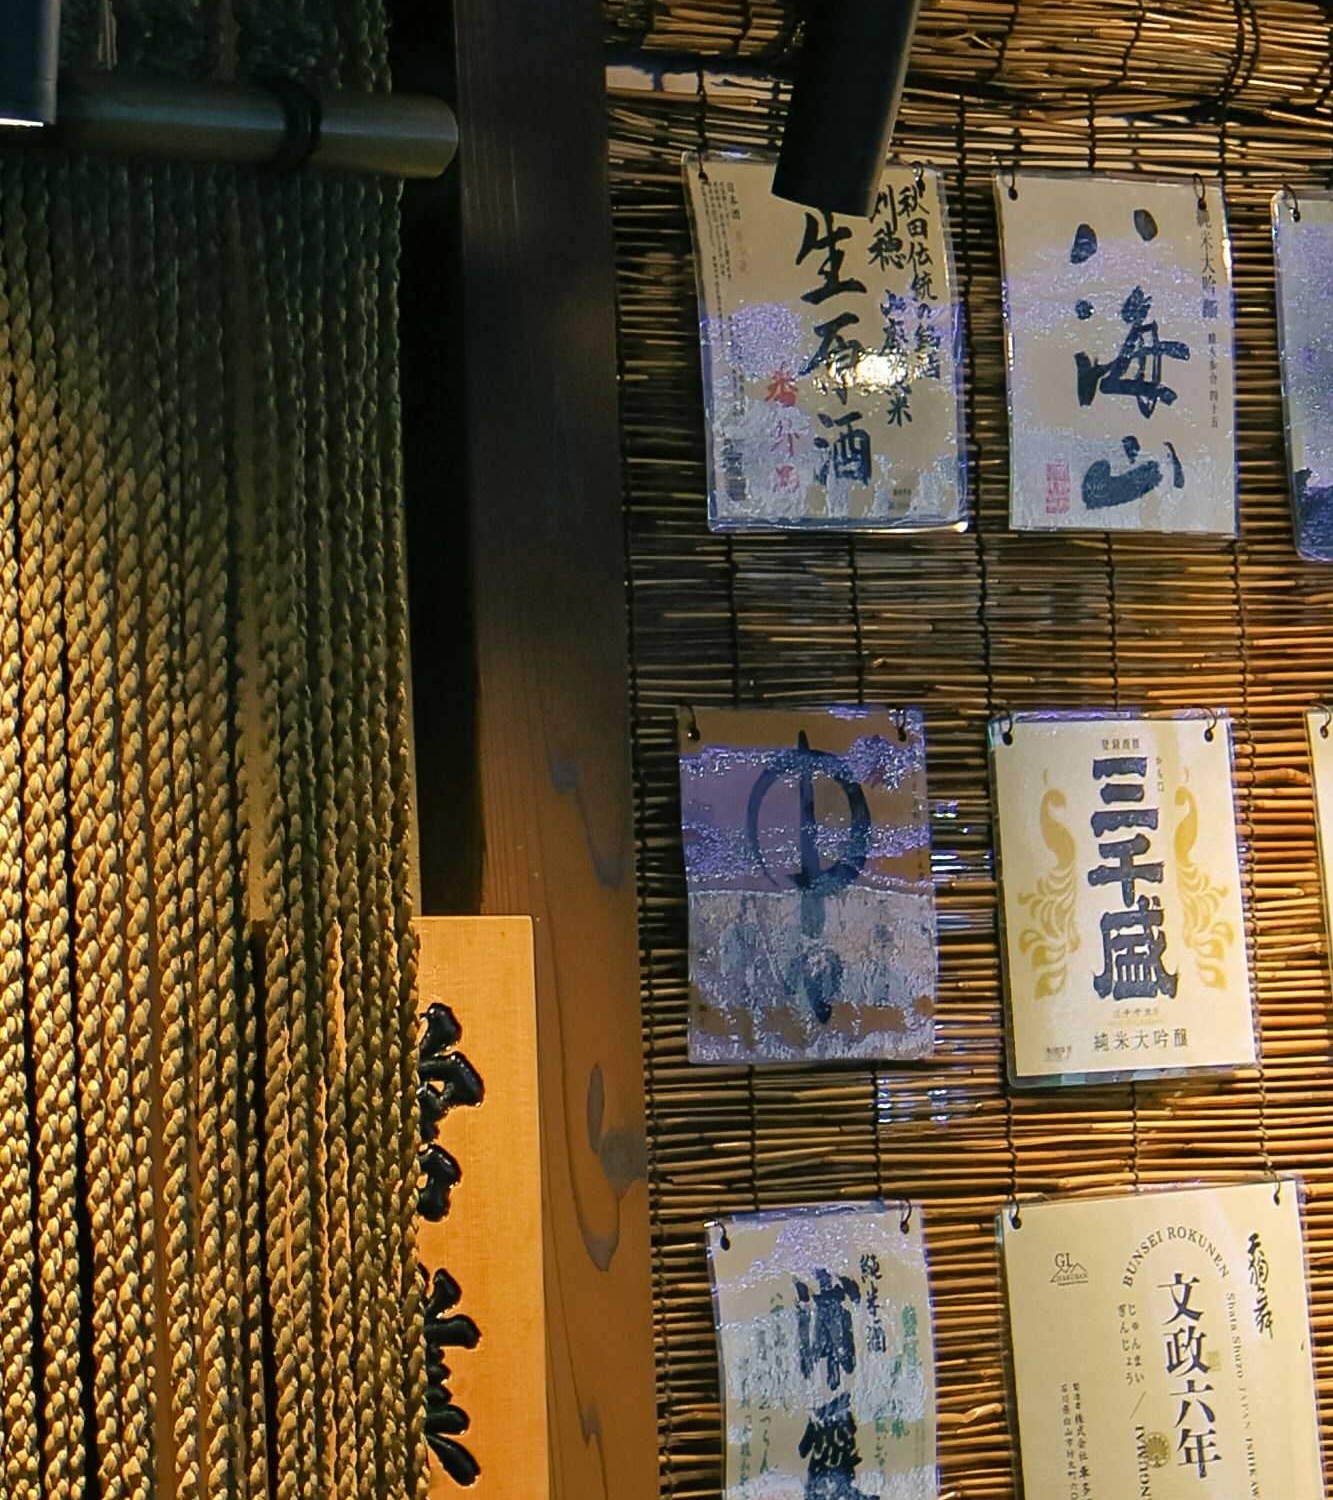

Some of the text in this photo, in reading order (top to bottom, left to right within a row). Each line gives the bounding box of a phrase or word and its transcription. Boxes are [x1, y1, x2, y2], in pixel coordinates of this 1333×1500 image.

[1069, 208, 1191, 511] 八海山
[1087, 756, 1180, 1001] 三千盛
[1092, 1027, 1189, 1052] 純米大吟醸
[859, 1253, 887, 1353] 純米酒
[1121, 1226, 1230, 1288] BUNSEI ROKUNEN
[1157, 1272, 1222, 1479] 文政六年
